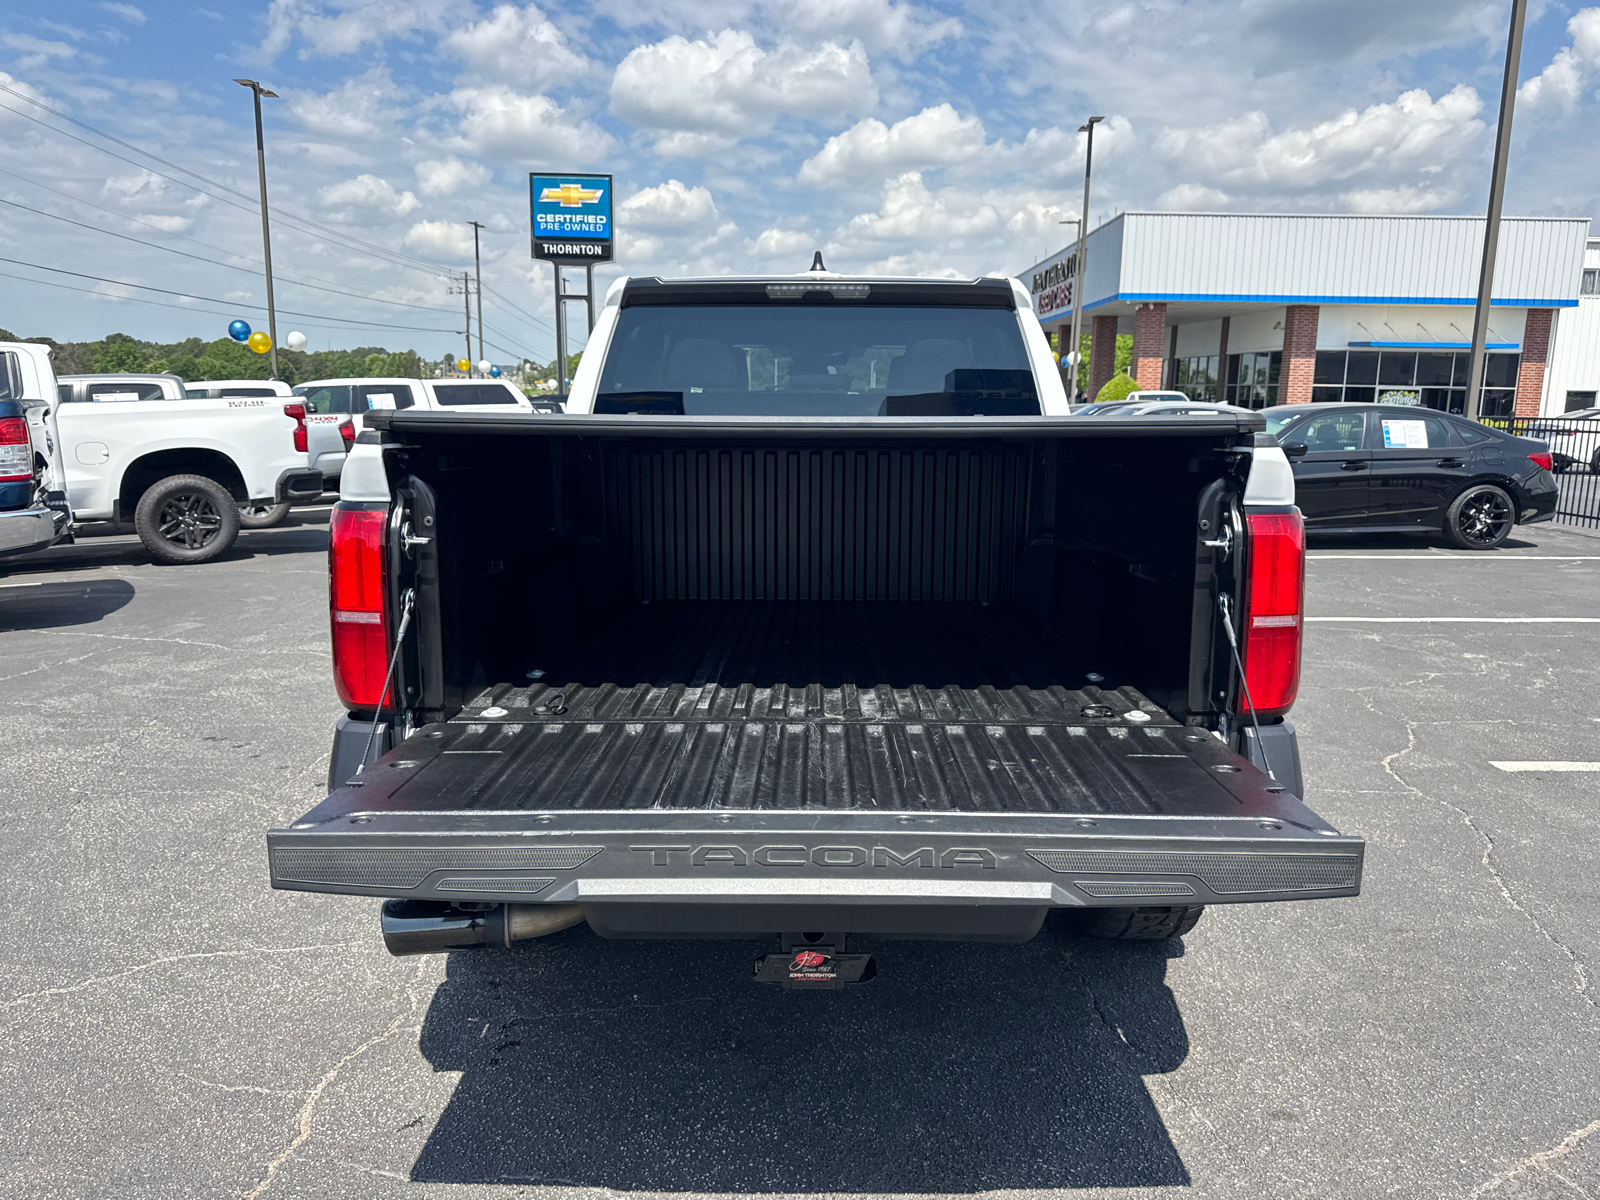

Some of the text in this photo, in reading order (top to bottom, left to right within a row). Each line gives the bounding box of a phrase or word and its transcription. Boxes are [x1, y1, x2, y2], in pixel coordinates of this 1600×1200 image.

[537, 214, 606, 223] CERTIFIED
[540, 223, 603, 231] PRE-OWNED
[543, 244, 602, 255] THORNTON
[1038, 281, 1072, 314] USED CARS
[629, 845, 997, 869] TACOMA
